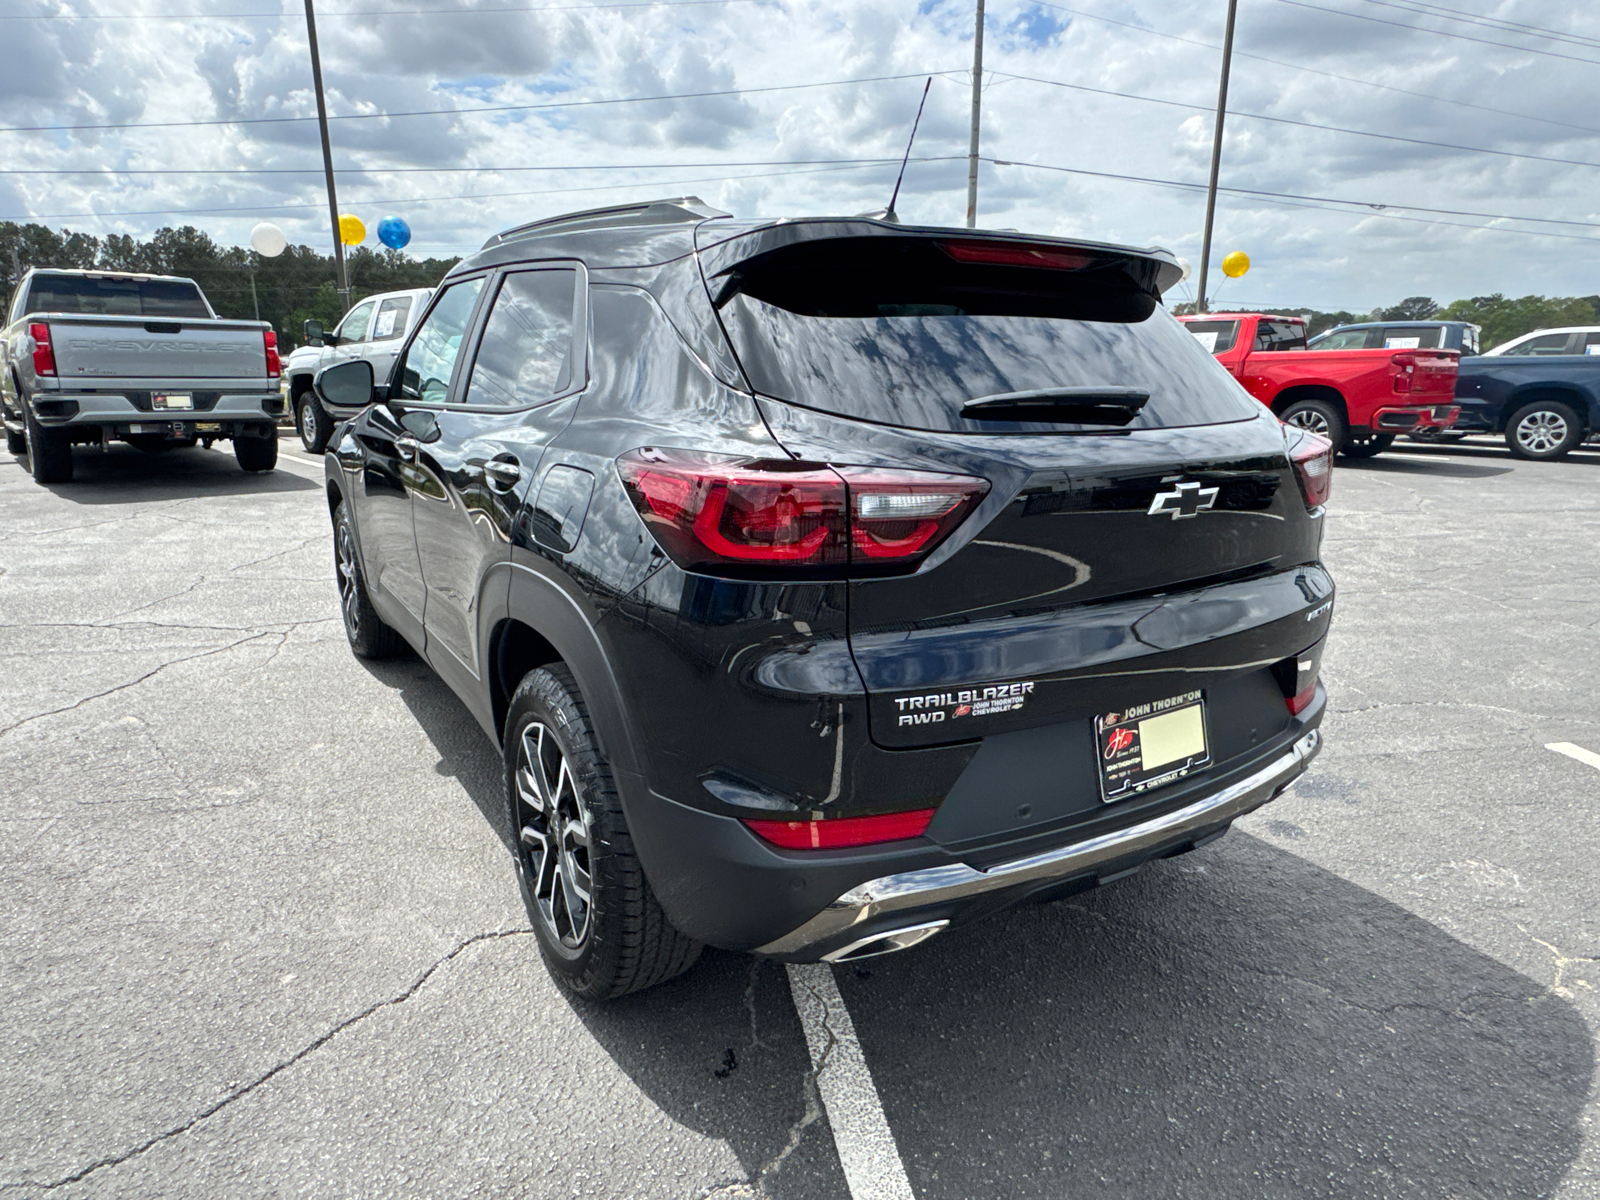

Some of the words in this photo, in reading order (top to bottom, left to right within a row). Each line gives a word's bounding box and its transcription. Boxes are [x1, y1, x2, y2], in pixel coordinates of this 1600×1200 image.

[894, 681, 1035, 711] TRAILBLAZER
[972, 701, 990, 710] JOHN
[990, 696, 1024, 708] THORNTON
[972, 704, 1012, 717] CHEVROLET
[1125, 704, 1151, 719] JOHN
[1152, 690, 1201, 711] THORNTON
[898, 711, 946, 726] AWD
[1106, 763, 1119, 772] JOHN
[1147, 773, 1178, 788] CHEVROLET
